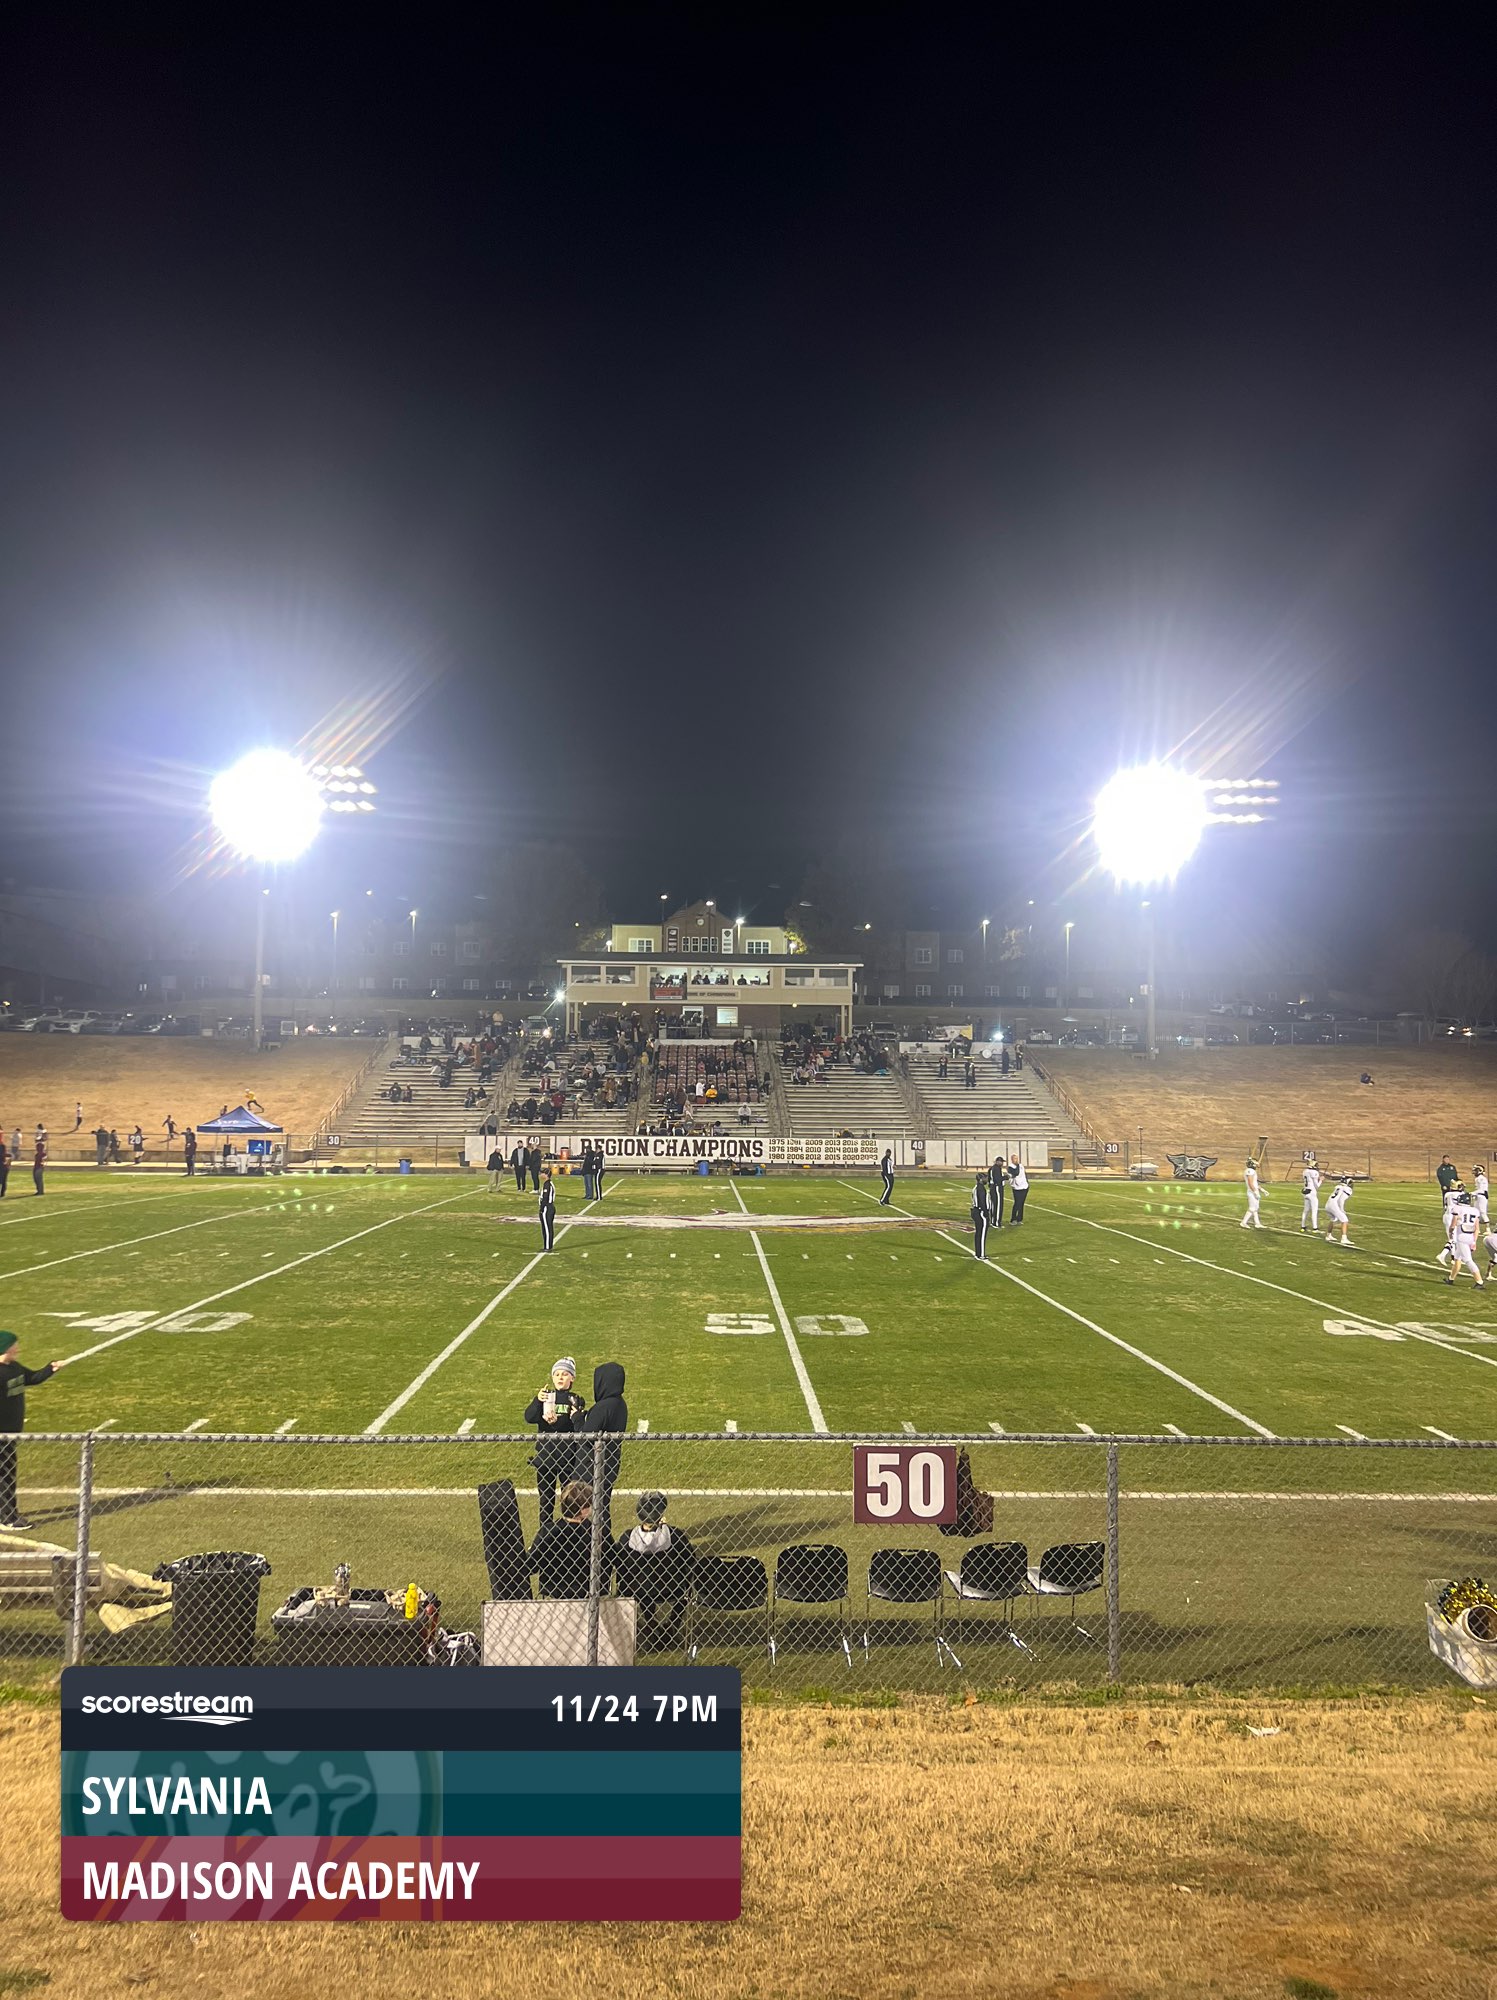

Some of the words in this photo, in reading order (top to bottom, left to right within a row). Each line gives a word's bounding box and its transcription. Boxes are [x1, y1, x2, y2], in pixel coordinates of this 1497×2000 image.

[130, 1135, 141, 1145] 20
[328, 1135, 340, 1145] 30
[529, 1136, 540, 1146] 40
[768, 1138, 785, 1146] 1975
[860, 1139, 877, 1147] 2021
[912, 1140, 924, 1150] 40
[580, 1138, 650, 1157] REGION
[653, 1138, 764, 1158] CHAMPIONS
[768, 1145, 785, 1153] 1976
[1106, 1143, 1118, 1153] 30
[824, 1153, 841, 1161] 2015
[842, 1153, 860, 1161] 2020
[1303, 1151, 1315, 1160] 20
[704, 1313, 869, 1336] 50
[866, 1452, 944, 1518] 50
